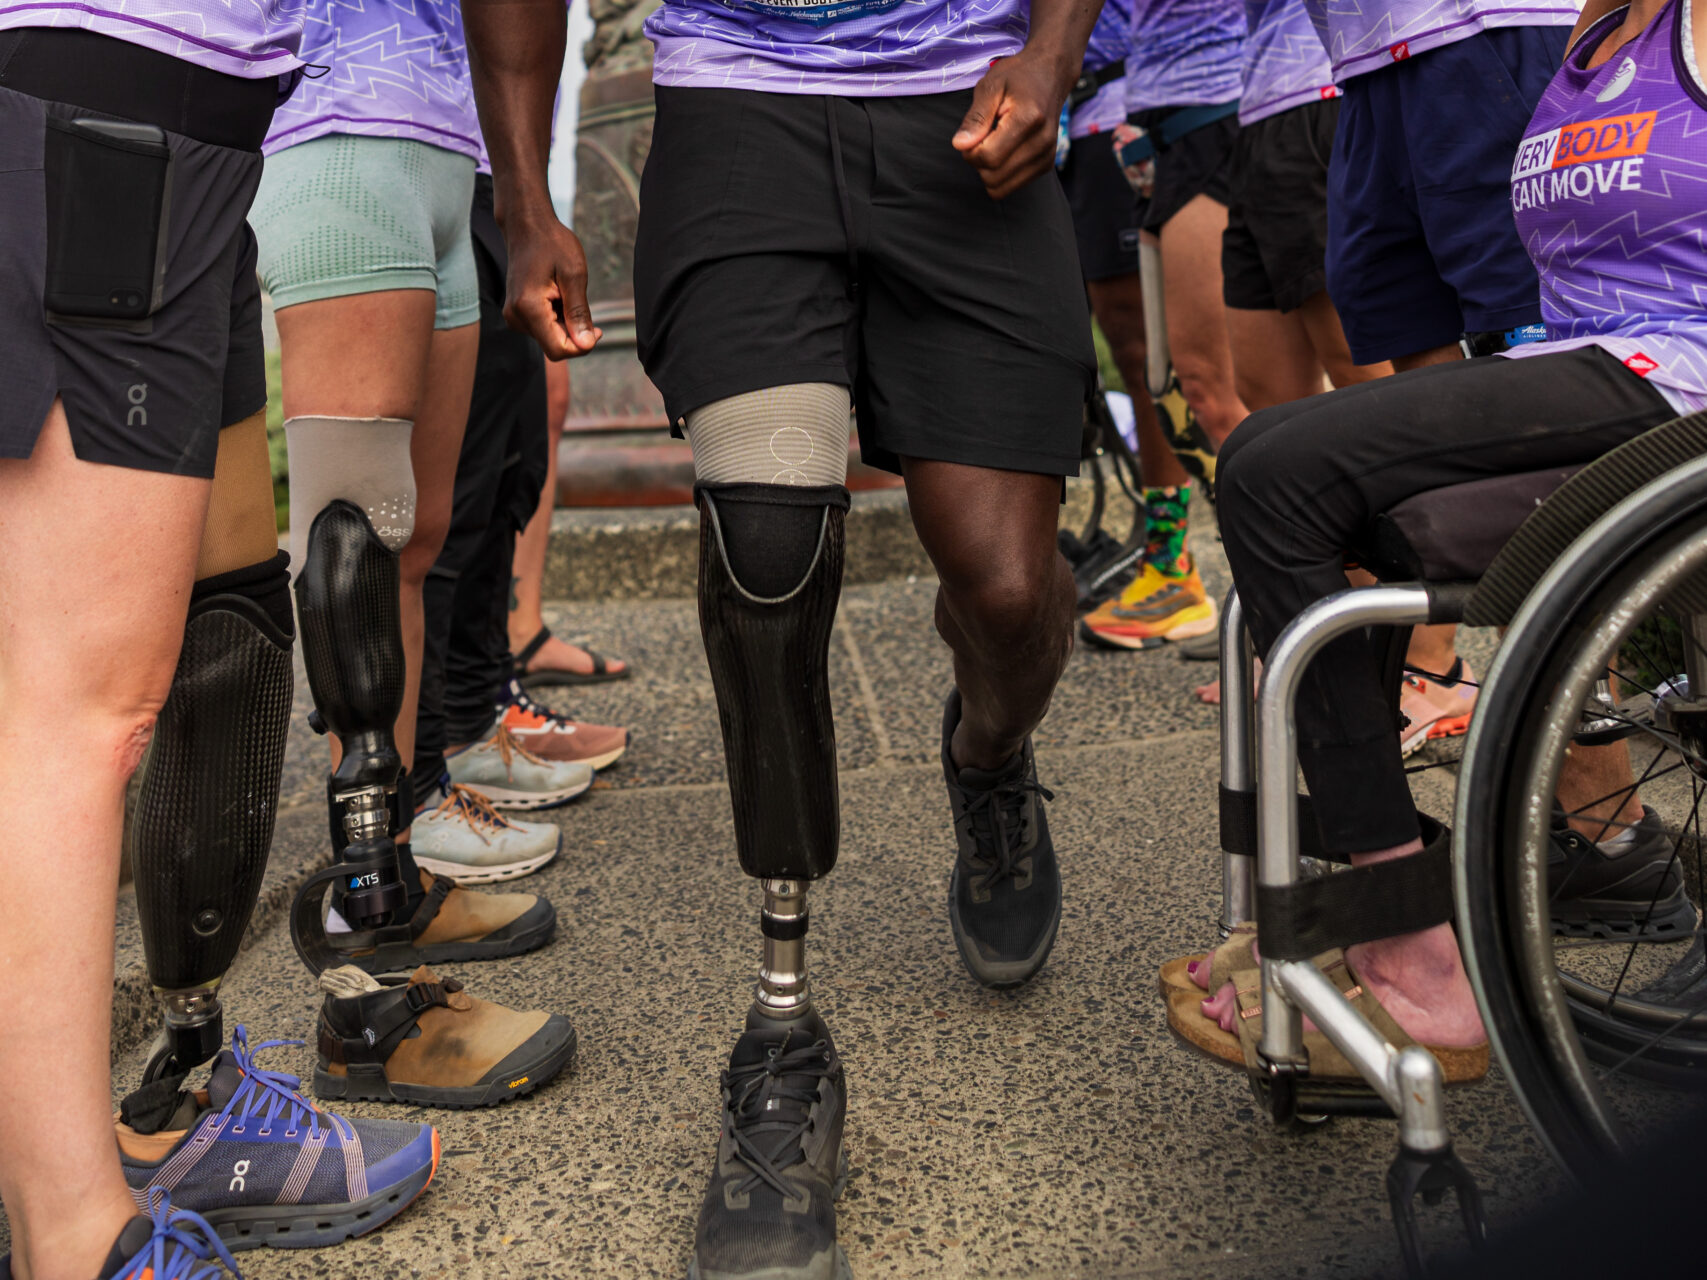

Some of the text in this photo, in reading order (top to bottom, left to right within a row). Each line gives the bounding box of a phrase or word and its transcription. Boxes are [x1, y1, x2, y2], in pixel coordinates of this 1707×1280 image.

[1513, 118, 1649, 175] VERY BODY
[1512, 157, 1644, 213] CAN MOVE
